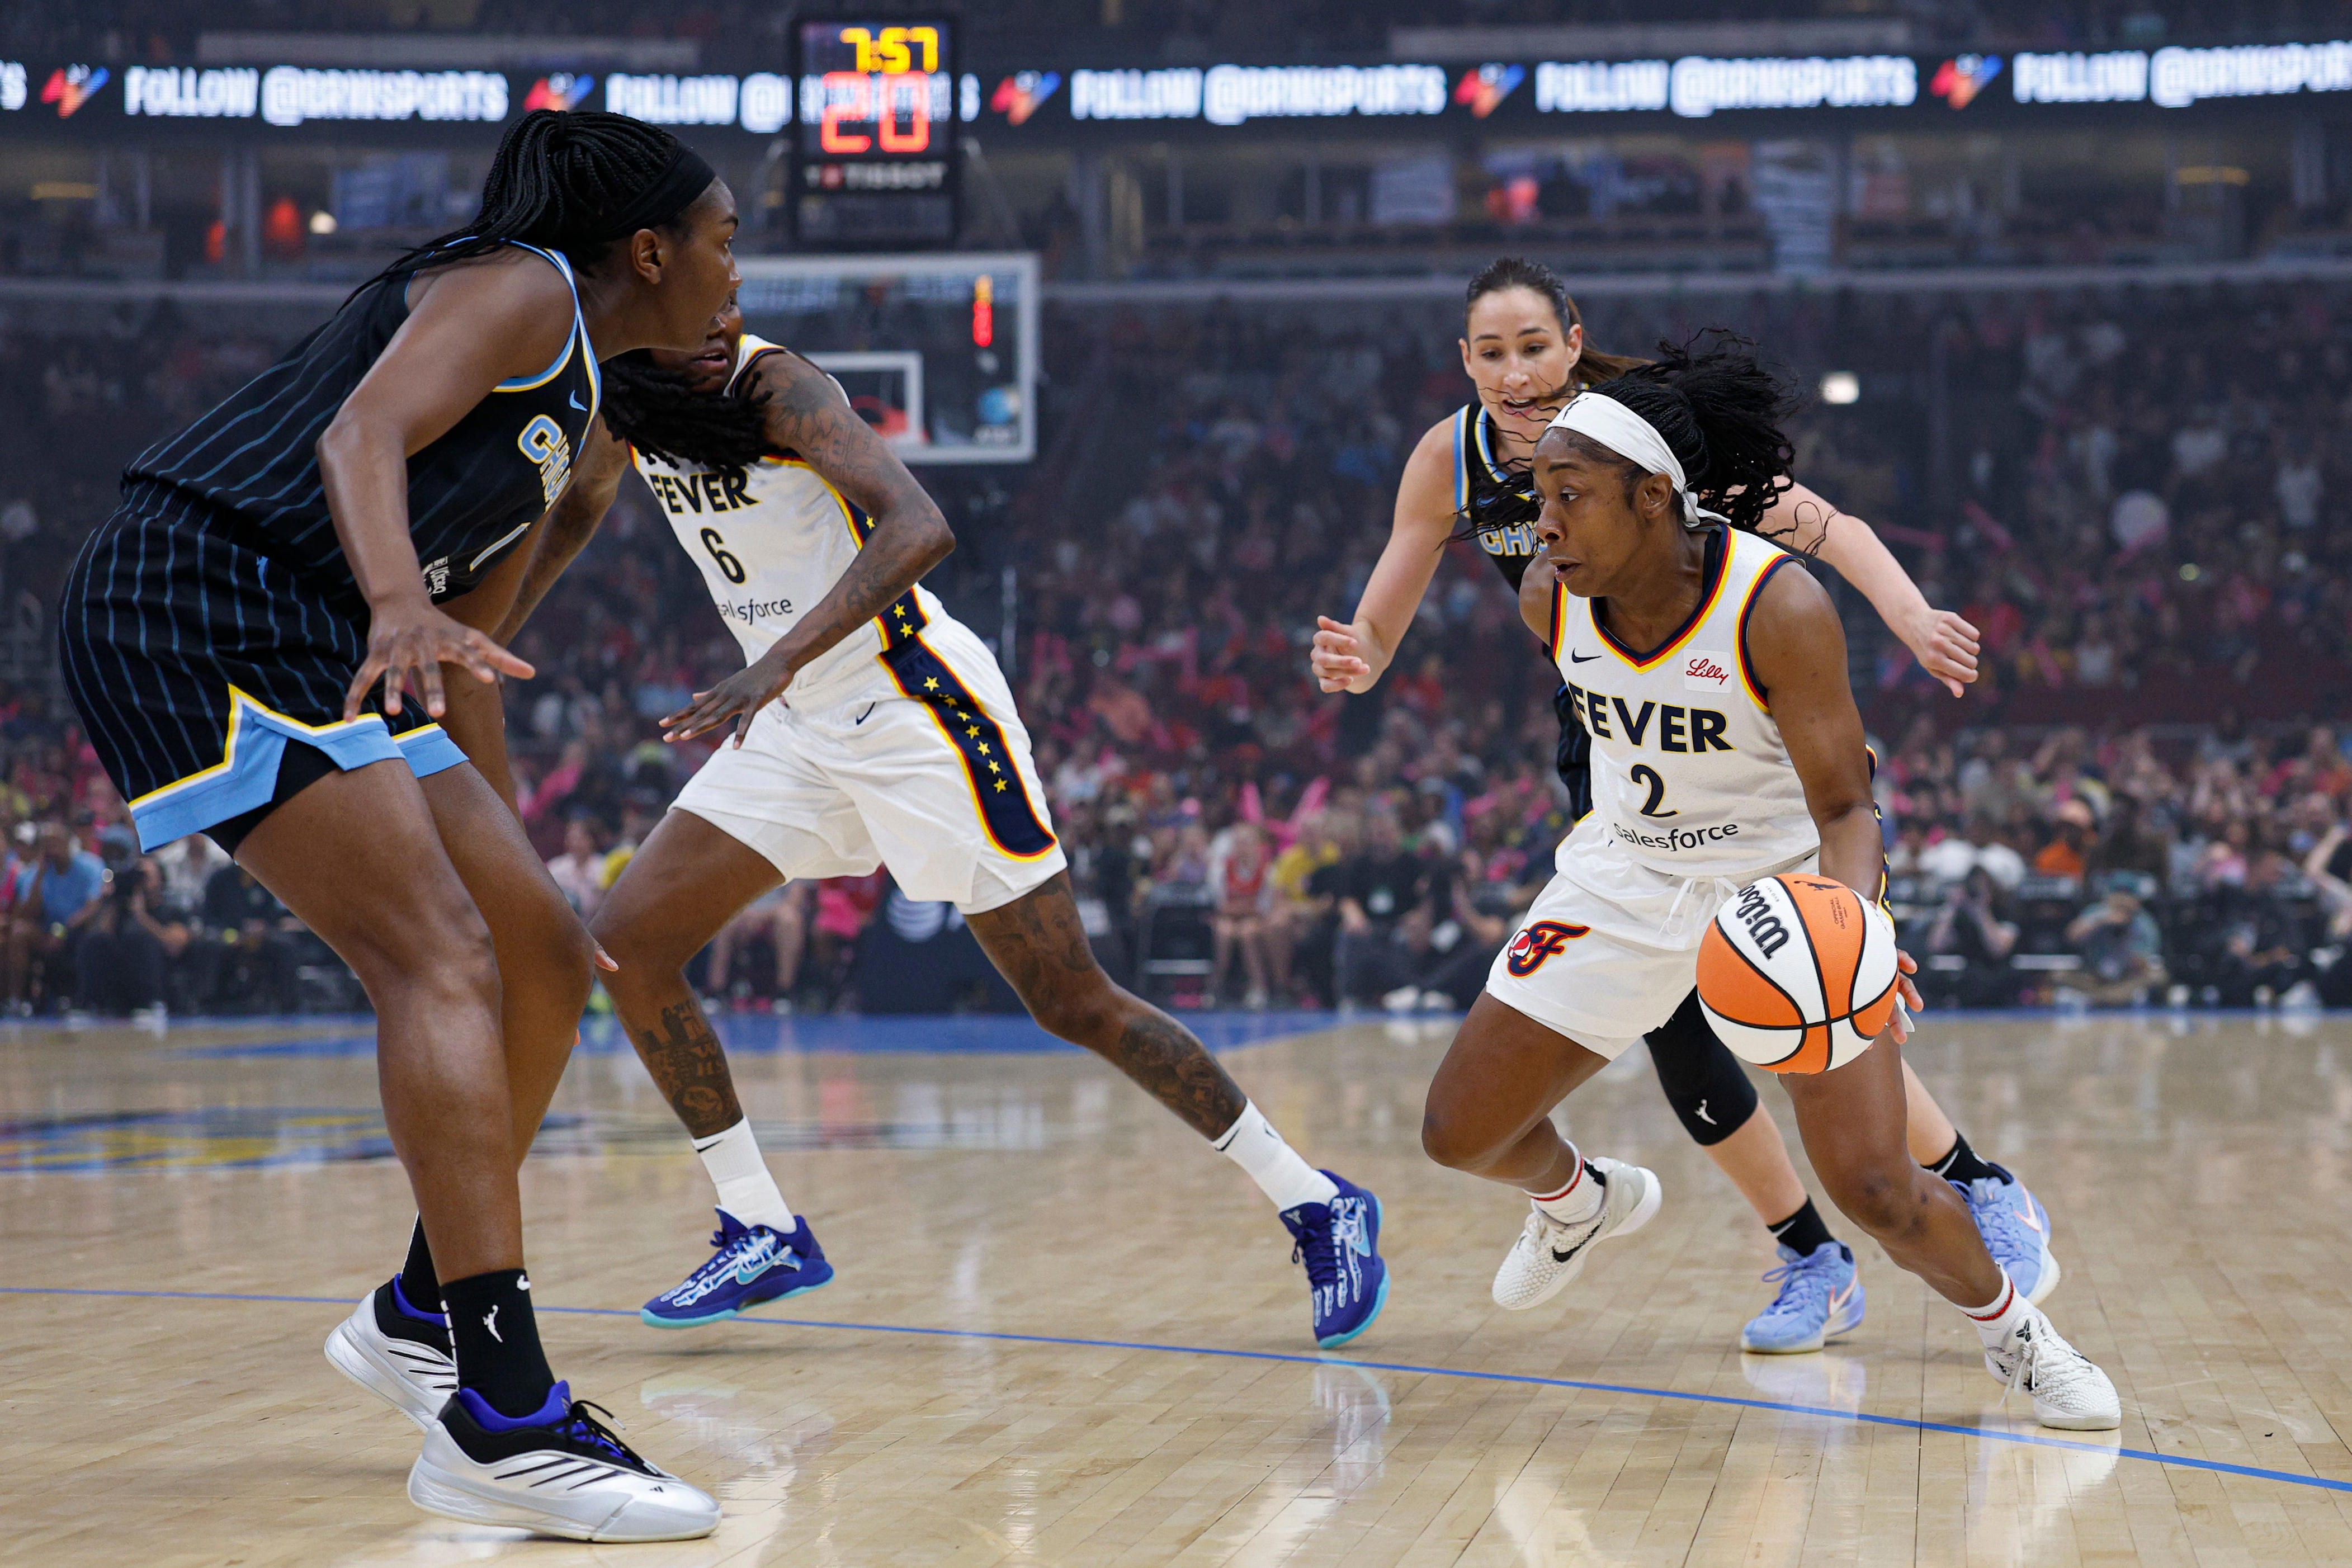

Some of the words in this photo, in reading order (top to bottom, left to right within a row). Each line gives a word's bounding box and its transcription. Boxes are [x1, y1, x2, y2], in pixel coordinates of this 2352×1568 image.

[840, 26, 938, 74] 7:57
[125, 67, 258, 117] FOLLOW
[606, 73, 738, 124] FOLLOW
[1071, 68, 1202, 119] FOLLOW
[1536, 60, 1668, 112] FOLLOW
[2013, 51, 2148, 102] FOLLOW
[821, 70, 930, 153] 20
[649, 466, 762, 514] FEVER
[700, 527, 745, 584] 6
[1685, 658, 1728, 686] Lilly
[1568, 680, 1737, 753] FEVER
[1631, 763, 1681, 818] 2
[1614, 823, 1739, 852] salesforce
